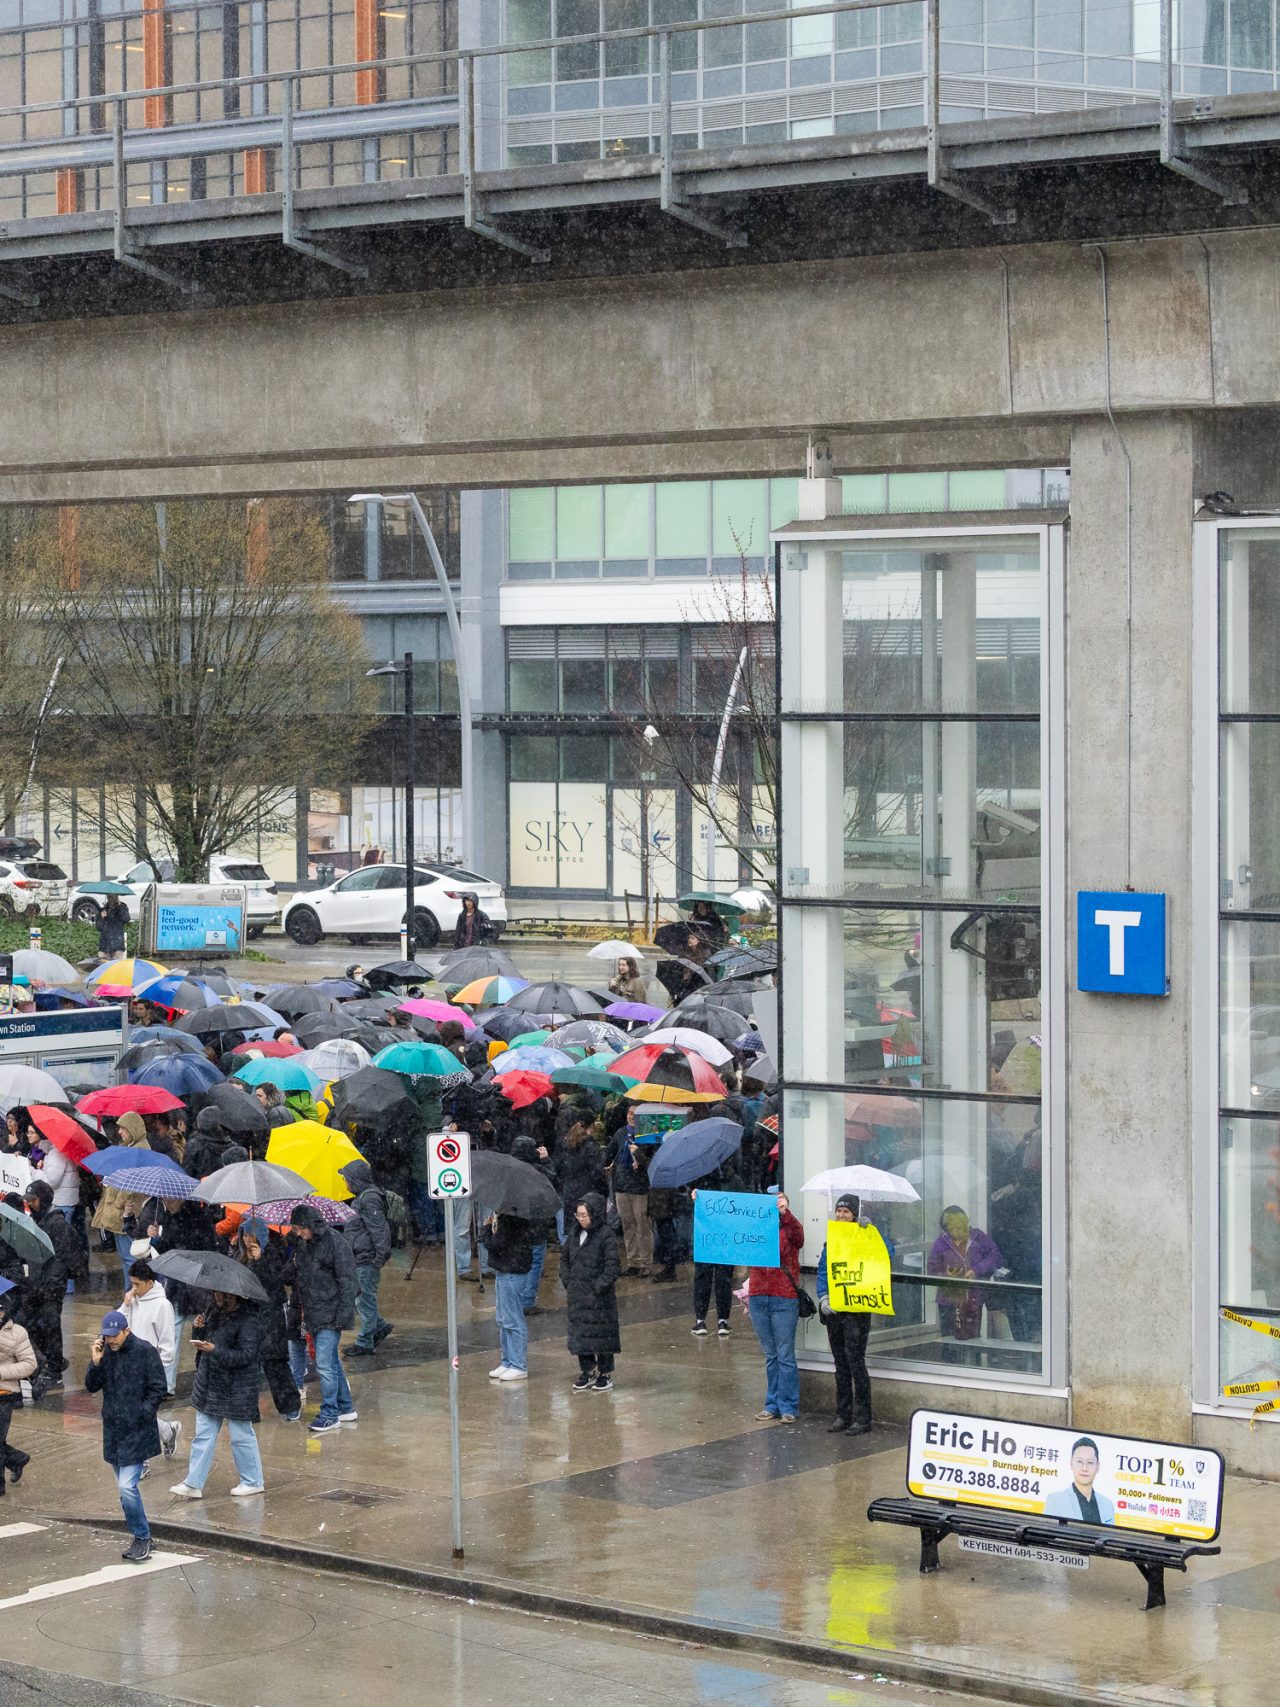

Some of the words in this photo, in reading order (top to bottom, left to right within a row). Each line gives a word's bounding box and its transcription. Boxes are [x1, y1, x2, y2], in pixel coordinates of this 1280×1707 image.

[525, 821, 594, 852] SKY
[161, 916, 199, 924] feel-good
[1095, 909, 1142, 976] T
[9, 1023, 36, 1033] Station
[706, 1197, 728, 1216] 50%
[831, 1262, 864, 1282] Fund
[835, 1282, 890, 1308] Transit
[1229, 1383, 1260, 1395] CAUTION
[925, 1421, 974, 1450] Eric
[981, 1429, 1017, 1456] Ho
[992, 1459, 1029, 1474] Burnaby
[1030, 1465, 1058, 1477] Expert
[1115, 1454, 1153, 1474] TOP
[938, 1466, 1041, 1495] 778.388.8884
[1169, 1477, 1195, 1490] TEAM
[1148, 1492, 1183, 1504] Followers
[962, 1539, 1012, 1555] KEYBENCH
